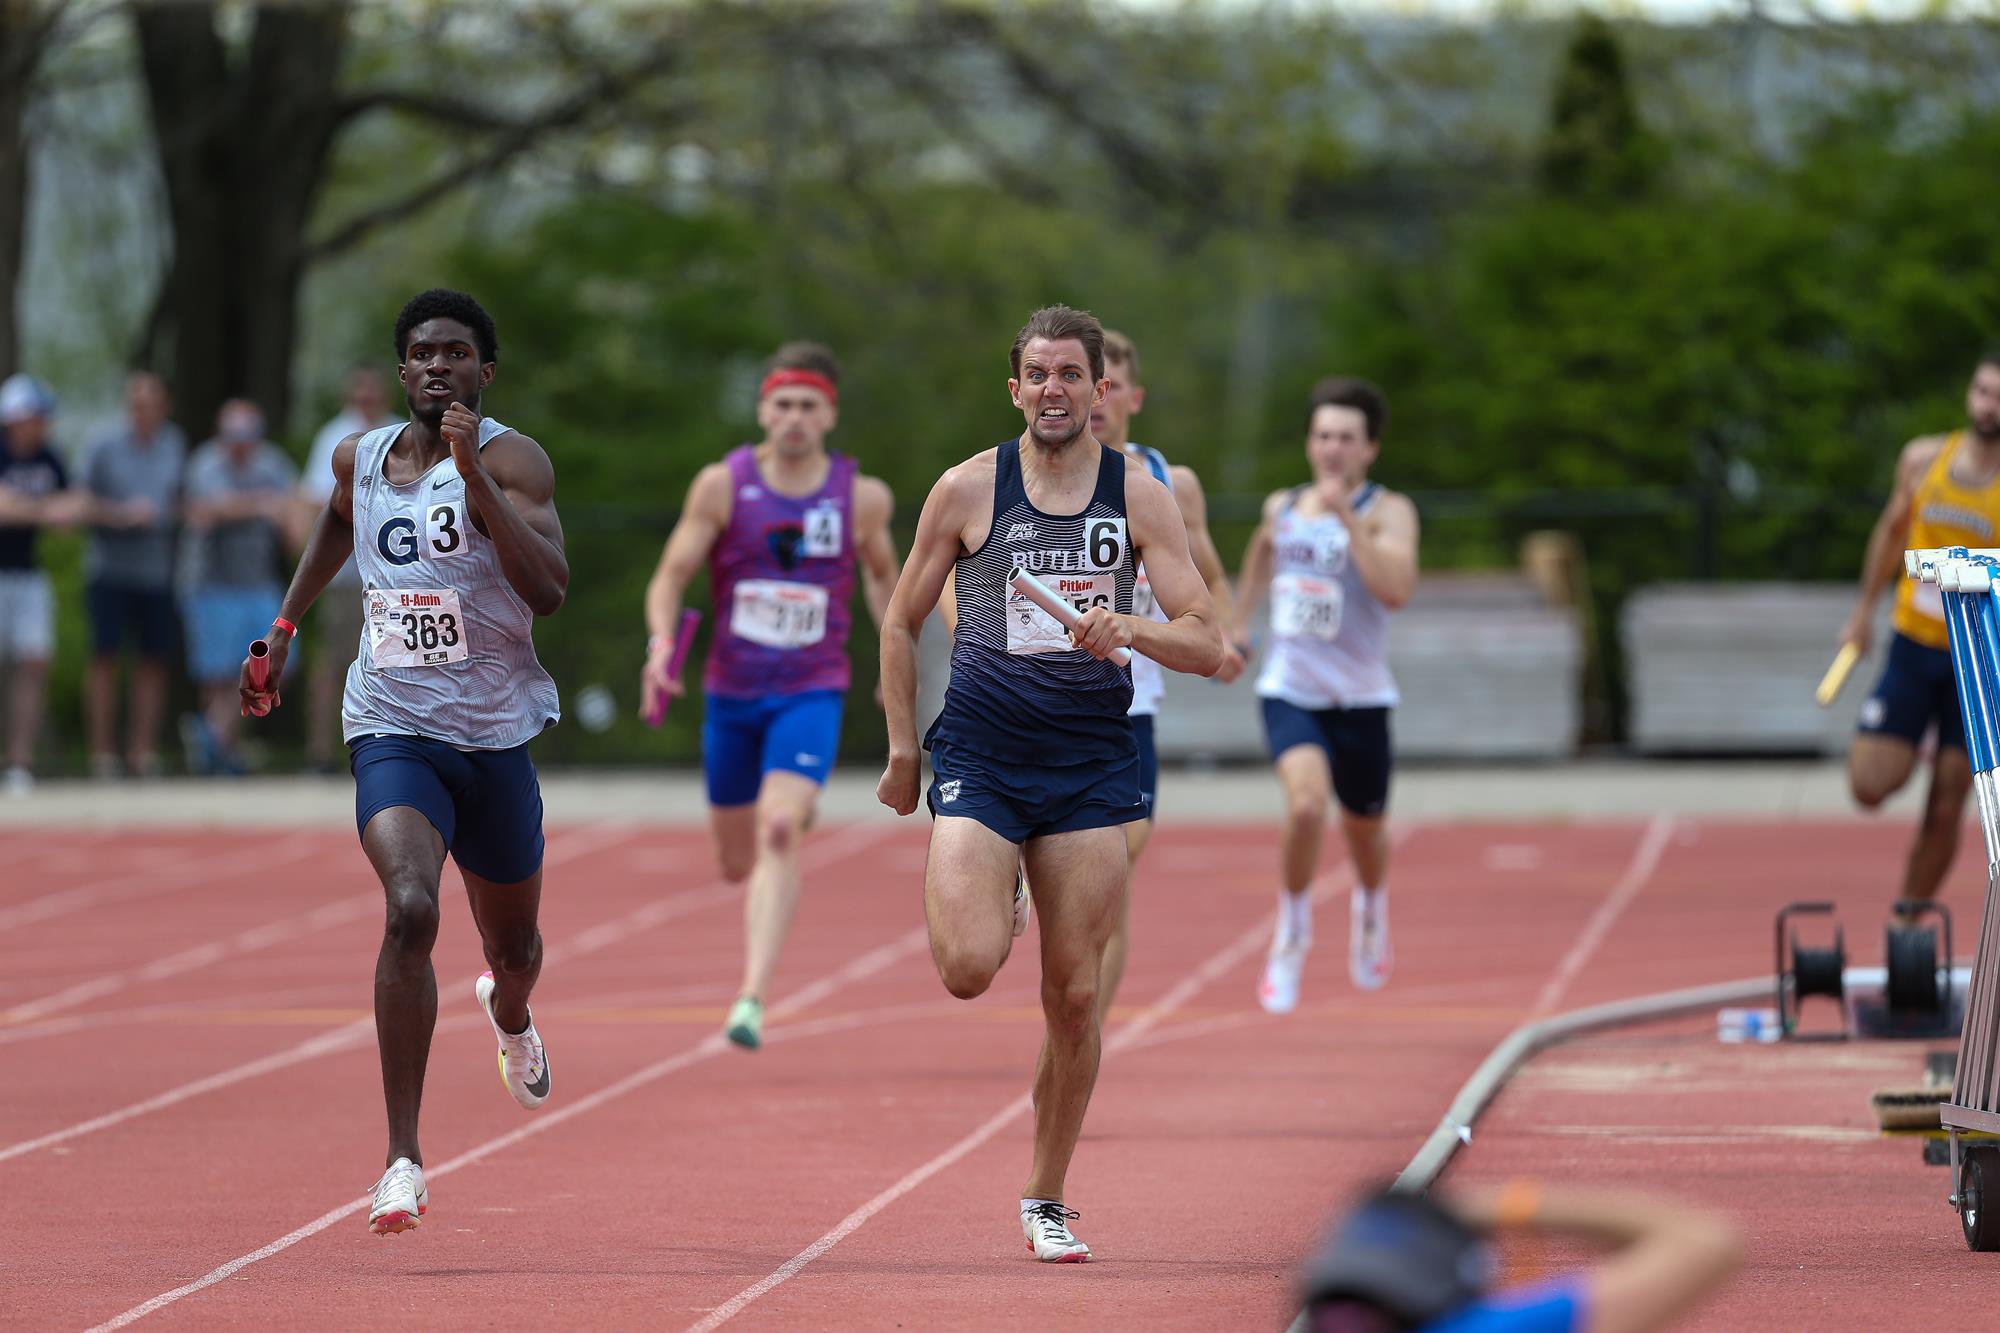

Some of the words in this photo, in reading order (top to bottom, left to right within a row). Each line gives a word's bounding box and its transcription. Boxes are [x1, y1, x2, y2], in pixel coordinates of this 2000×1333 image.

[431, 505, 460, 554] 3
[1006, 530, 1040, 540] EAST
[1010, 523, 1034, 532] BIG
[377, 516, 422, 567] G
[1089, 521, 1119, 568] 6
[1011, 550, 1085, 571] BUTL
[1060, 580, 1093, 592] Pitkin
[401, 594, 441, 606] El-Amin
[401, 613, 459, 651] 363
